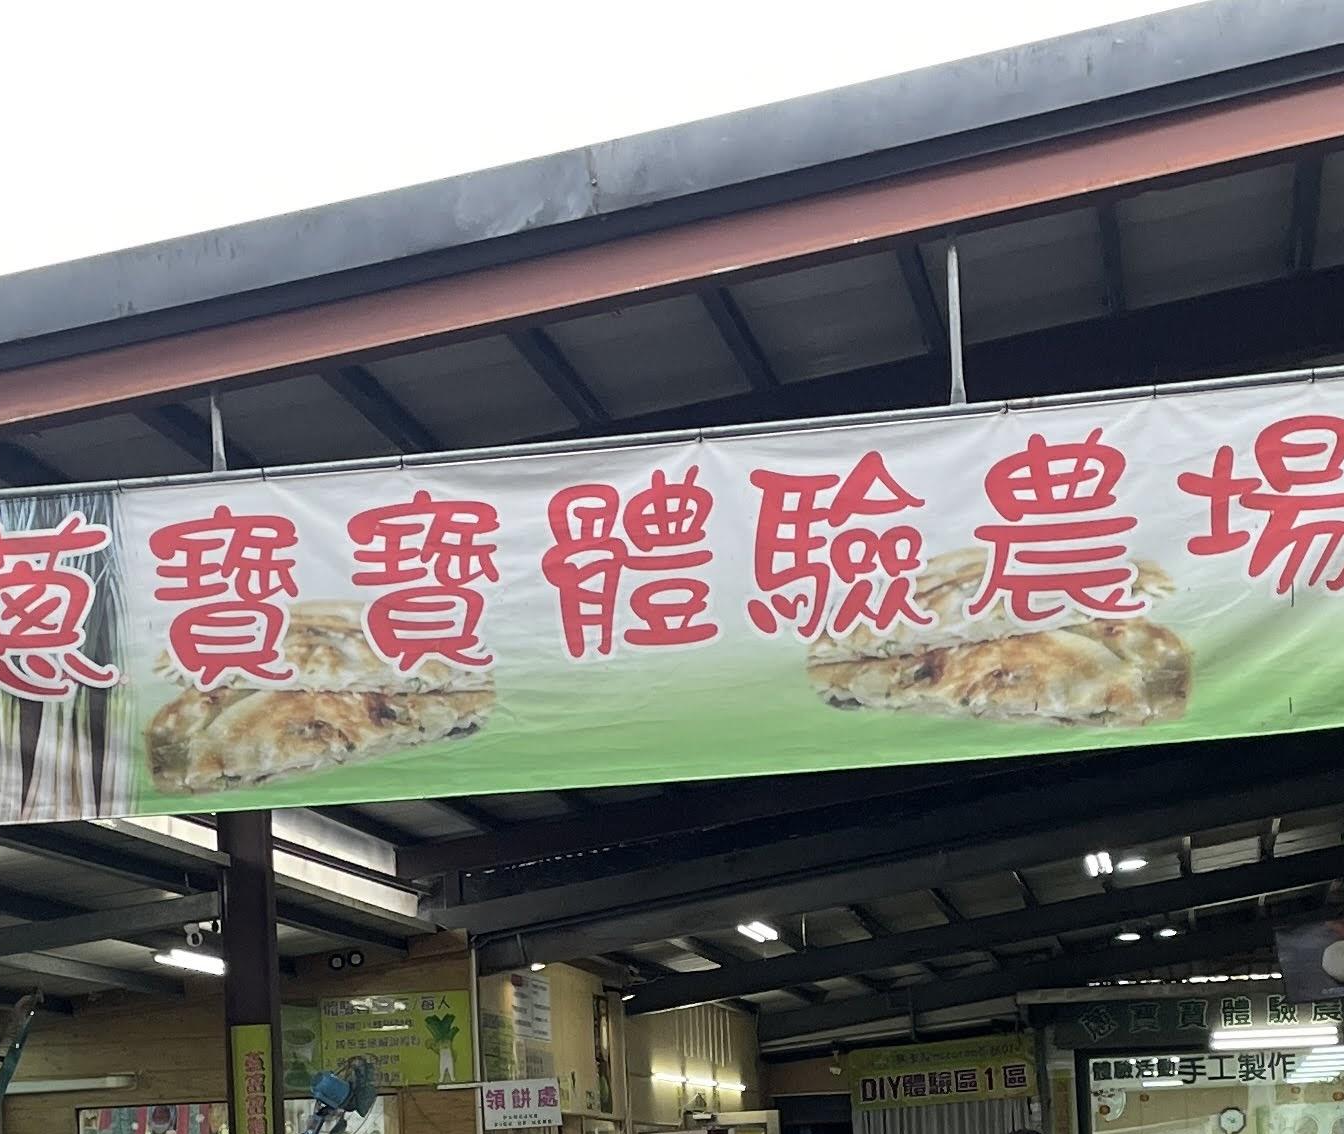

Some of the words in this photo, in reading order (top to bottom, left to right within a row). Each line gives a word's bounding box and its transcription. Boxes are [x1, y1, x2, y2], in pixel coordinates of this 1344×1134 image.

[1178, 1051, 1297, 1085] 手工製作
[485, 1086, 559, 1110] 領餅處
